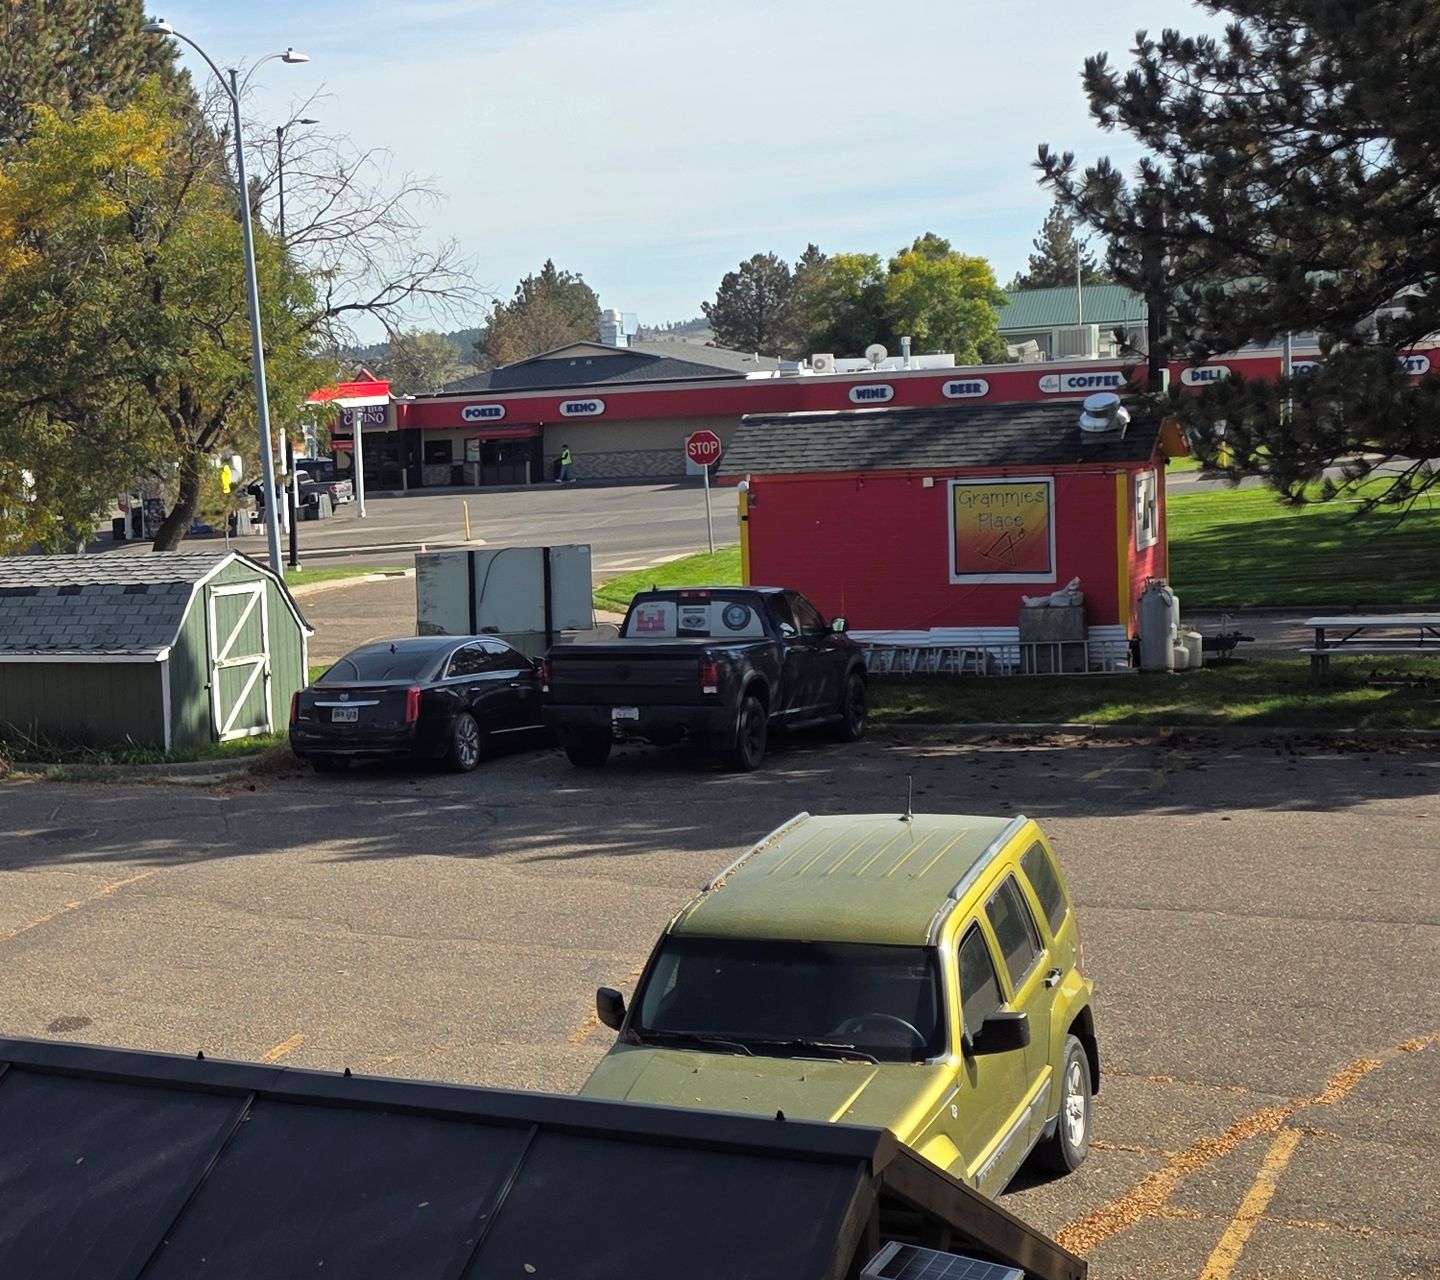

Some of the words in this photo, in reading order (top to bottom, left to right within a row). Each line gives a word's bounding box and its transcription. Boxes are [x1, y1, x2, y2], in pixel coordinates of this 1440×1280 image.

[1191, 370, 1221, 381] DELI
[1067, 375, 1120, 388] COFFEE
[855, 388, 887, 399] WINE
[949, 383, 982, 394] BEER
[465, 408, 501, 418] POKER
[566, 403, 597, 413] KENO
[343, 413, 384, 425] CINO
[689, 441, 718, 455] STOP
[978, 512, 1024, 531] Place
